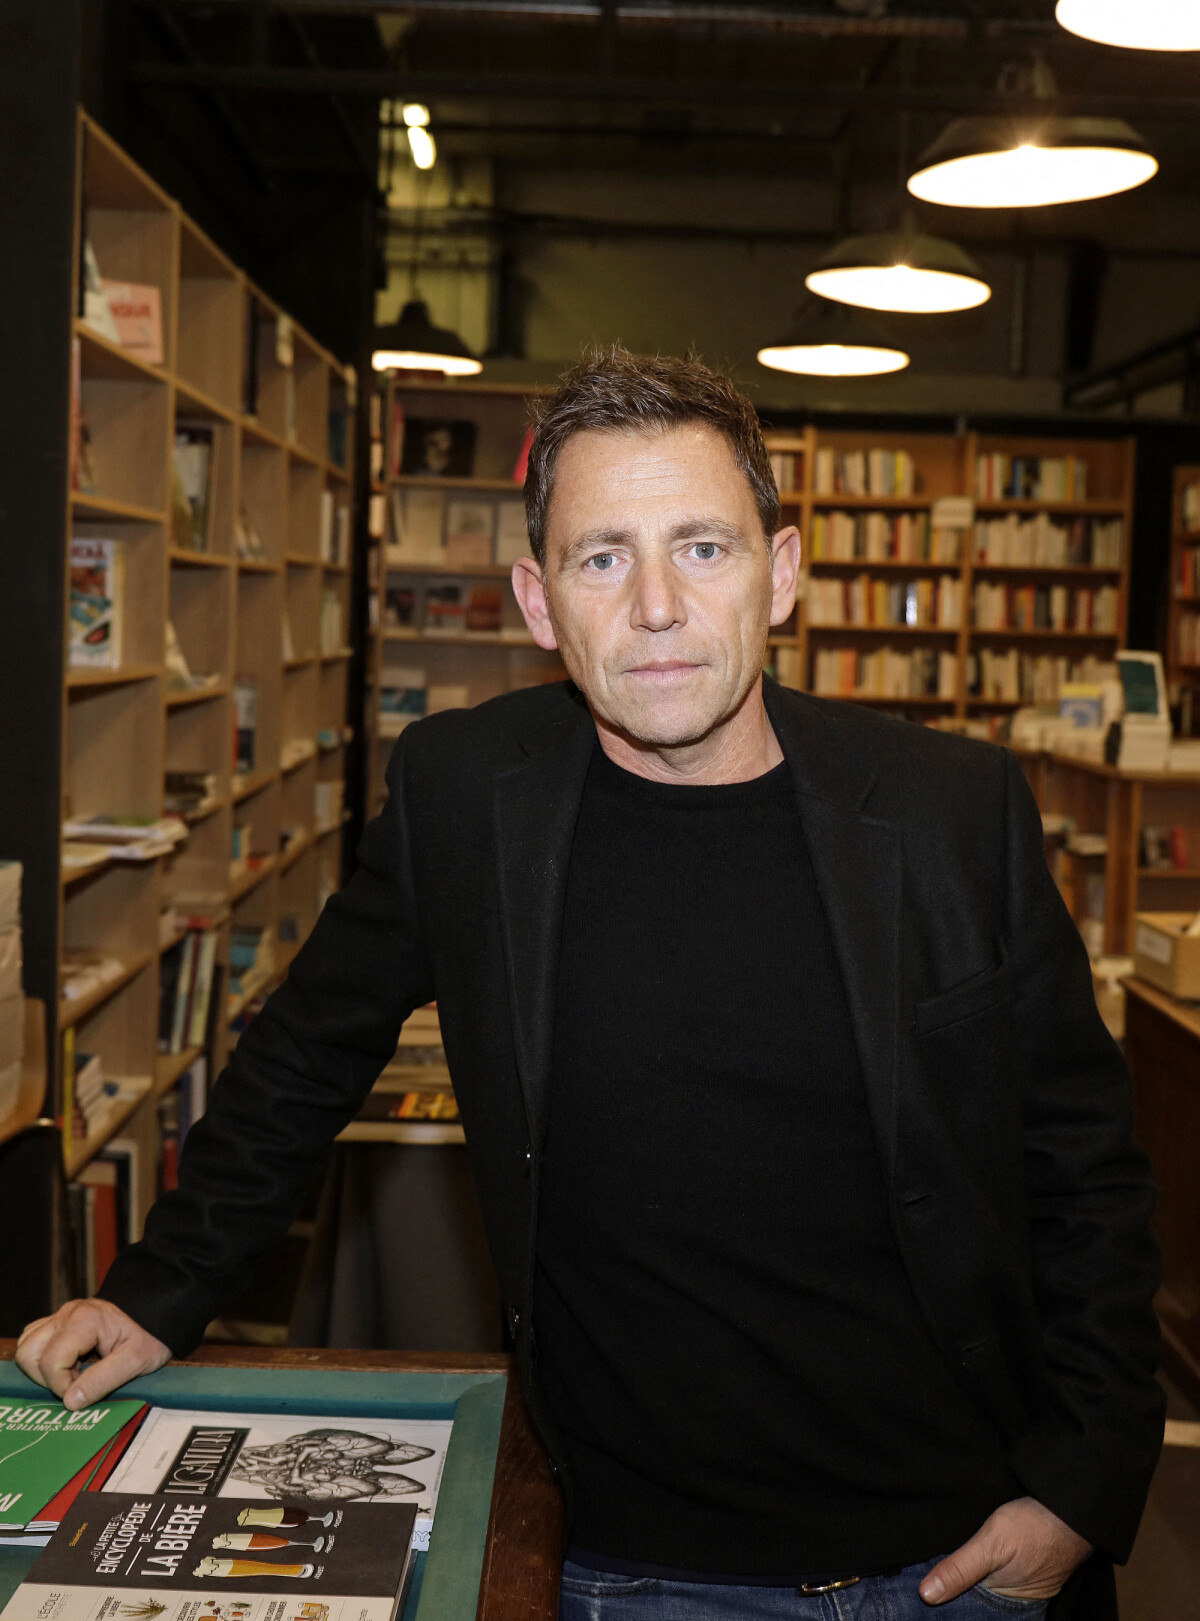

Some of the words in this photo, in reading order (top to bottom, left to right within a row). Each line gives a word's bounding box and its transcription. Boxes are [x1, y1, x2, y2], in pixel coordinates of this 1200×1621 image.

[62, 1423, 96, 1431] POUR
[163, 1430, 236, 1496] LIGATURA
[95, 1501, 153, 1574] ENCYCLOPÉDIE
[98, 1520, 120, 1543] PETITE
[138, 1531, 155, 1543] DE
[154, 1503, 208, 1551] BIÈRE
[93, 1537, 107, 1551] LA
[140, 1553, 184, 1577] LA
